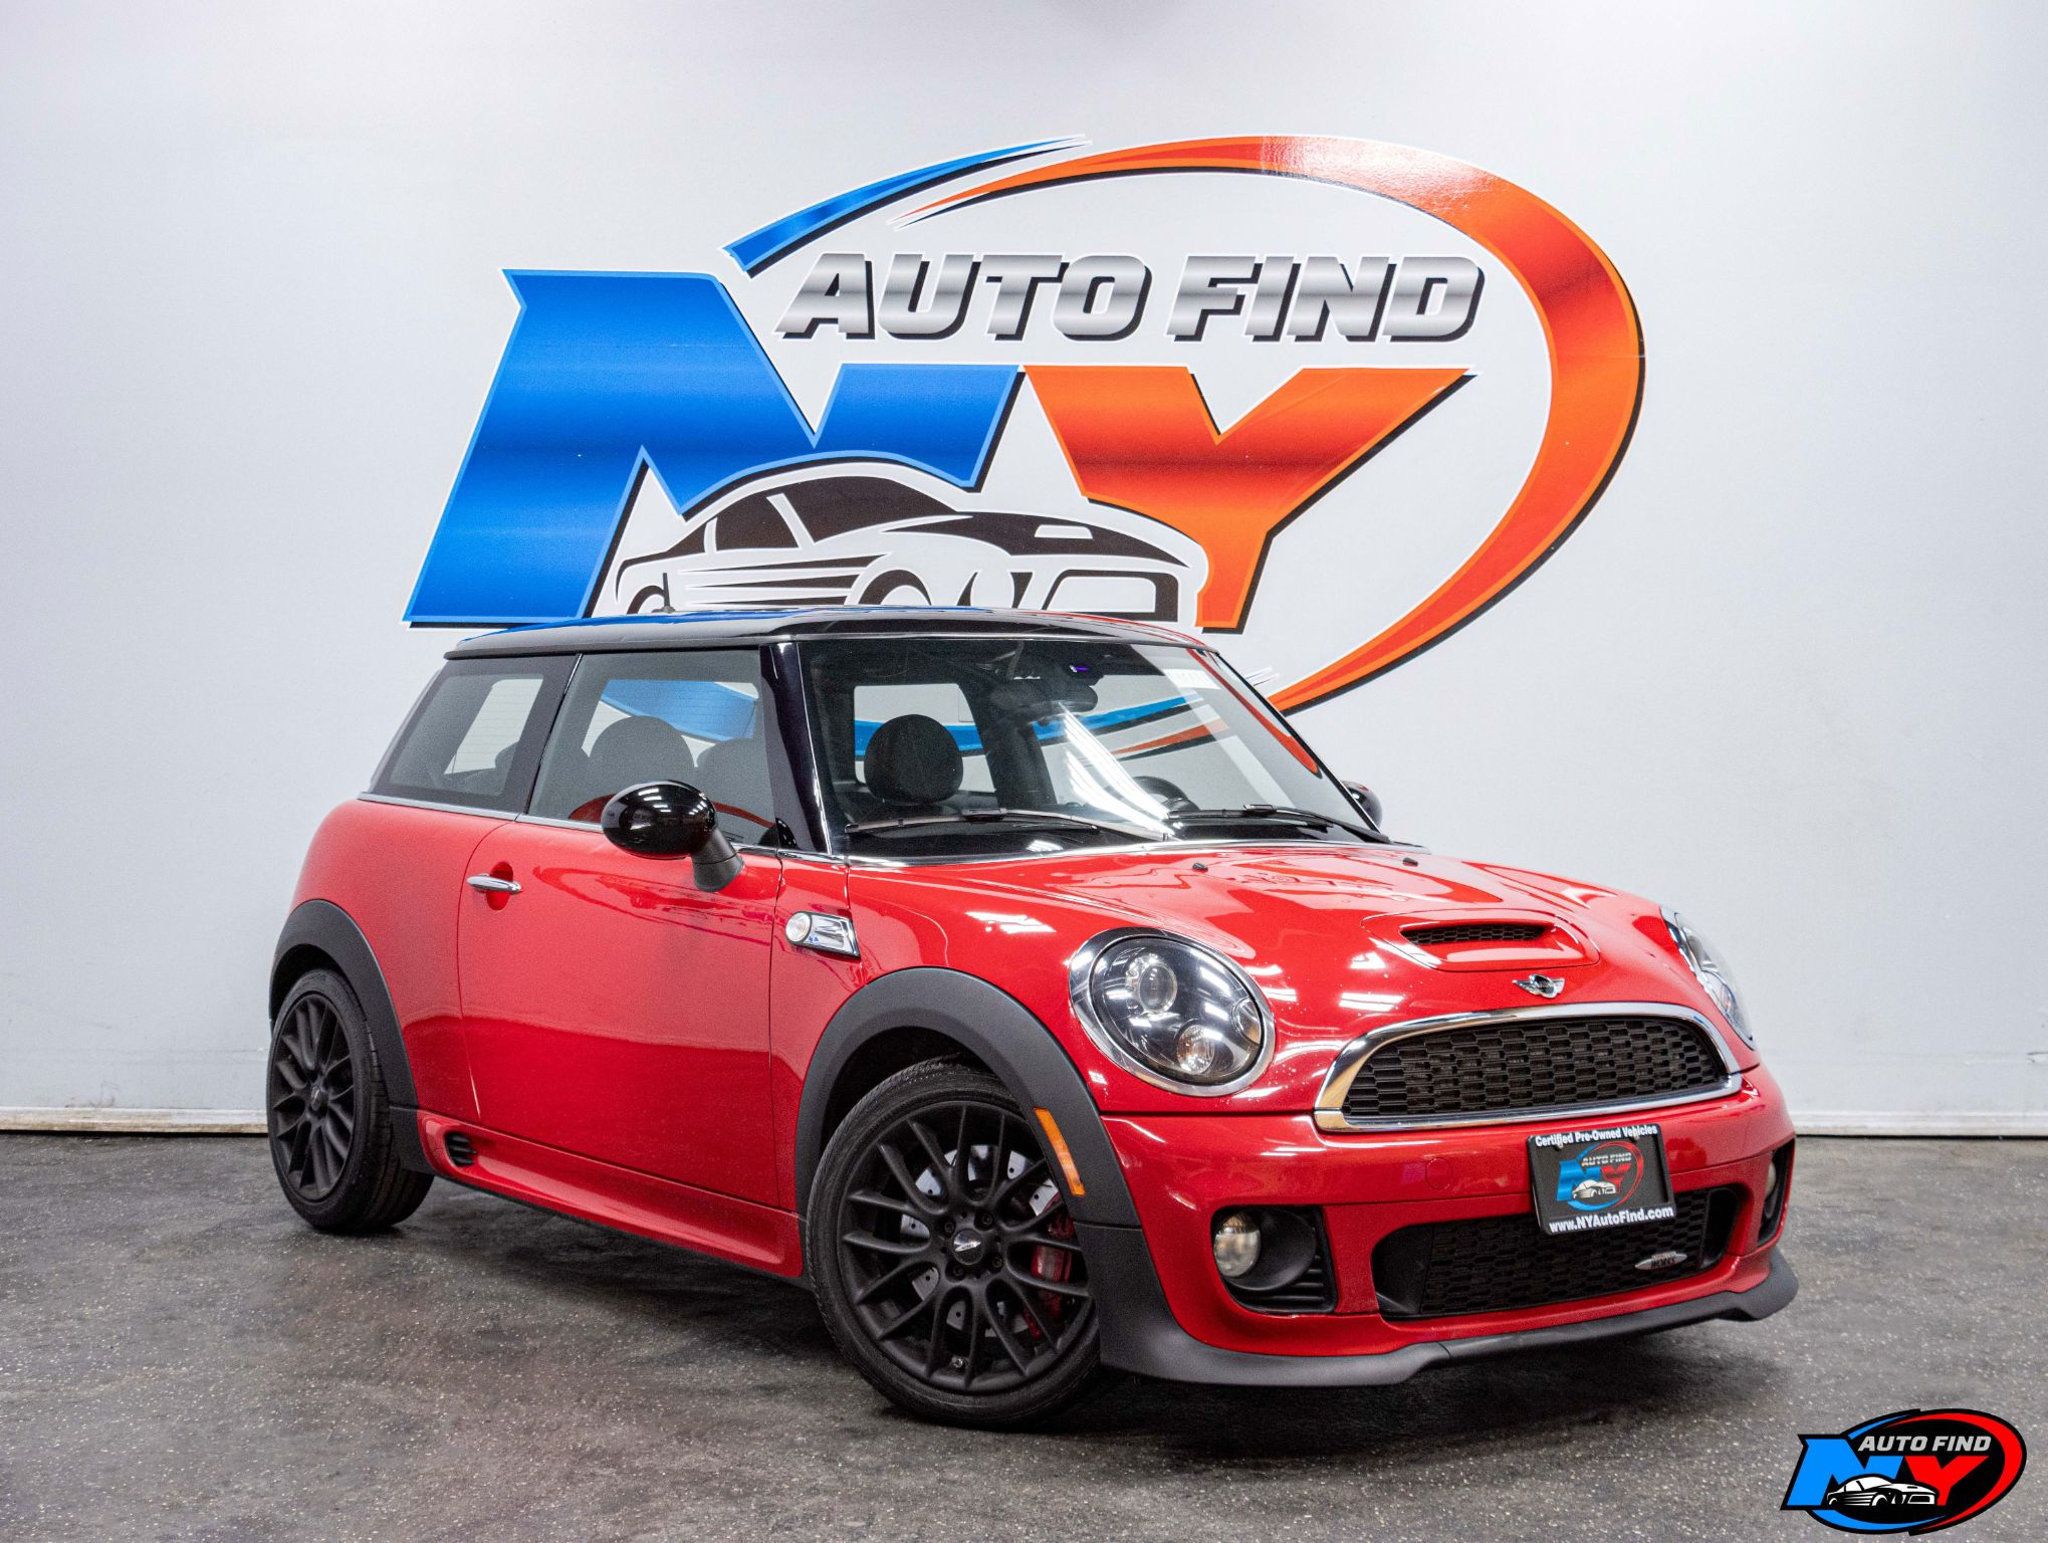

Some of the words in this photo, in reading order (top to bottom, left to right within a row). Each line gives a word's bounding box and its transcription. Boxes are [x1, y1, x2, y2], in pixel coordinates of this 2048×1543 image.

[777, 254, 1152, 342] AUTO
[1168, 256, 1485, 342] FIND
[403, 268, 1476, 636] NY
[1535, 1132, 1574, 1147] Certified
[1575, 1127, 1622, 1142] Pre-Owned
[1622, 1124, 1658, 1138] Vehicles
[1581, 1155, 1609, 1167] AUTO
[1610, 1152, 1632, 1163] FIND
[1549, 1206, 1674, 1233] www.NYAutoFind.com
